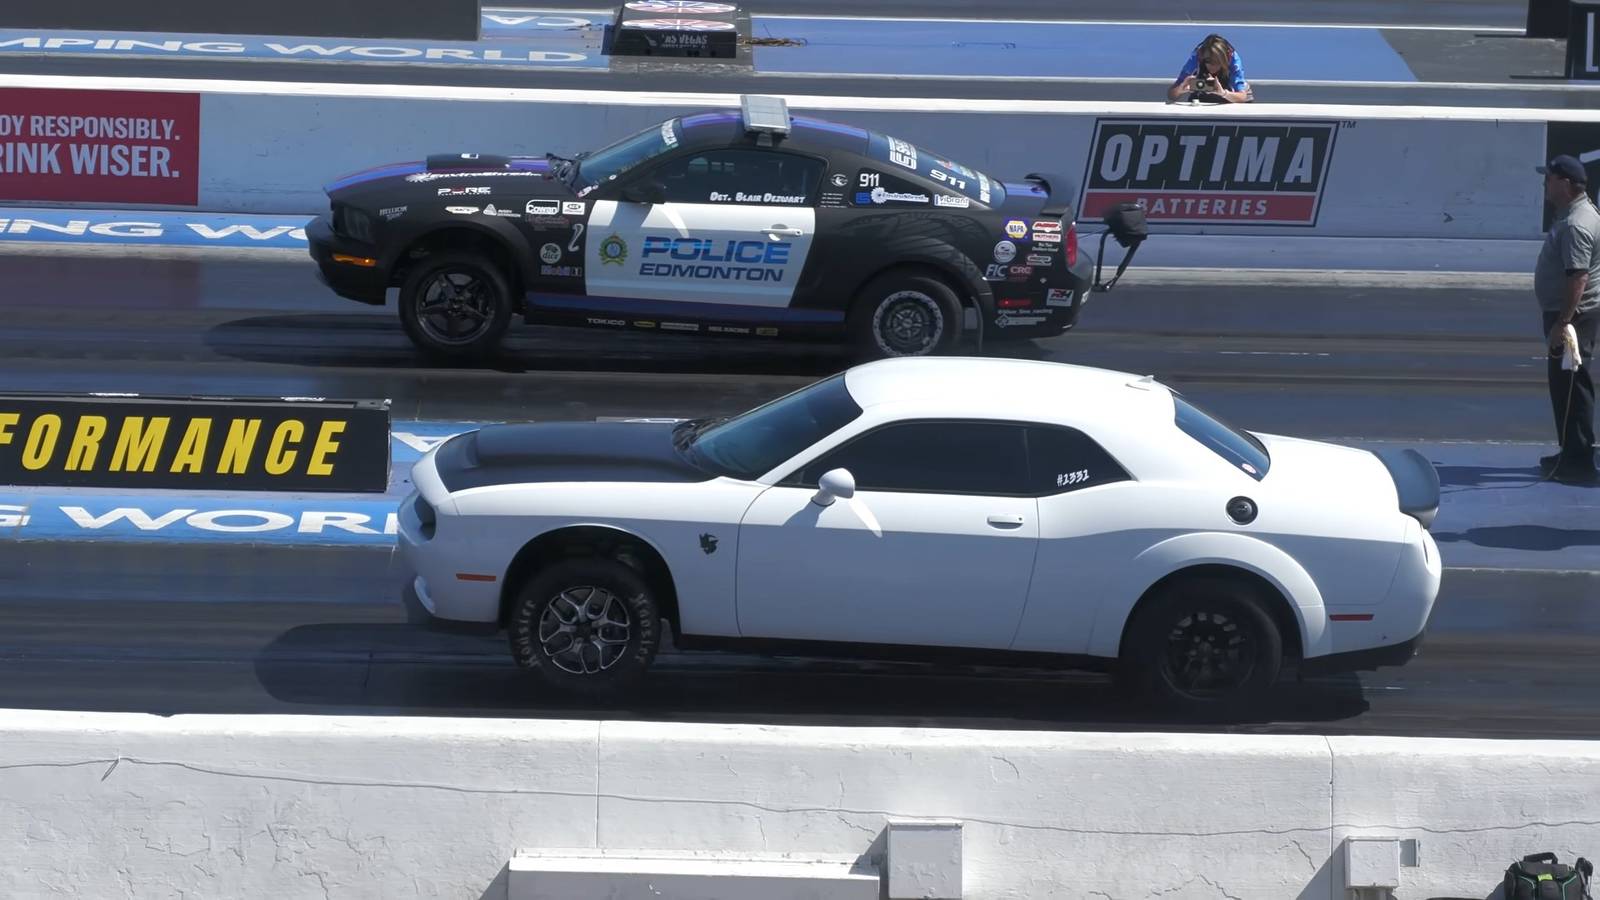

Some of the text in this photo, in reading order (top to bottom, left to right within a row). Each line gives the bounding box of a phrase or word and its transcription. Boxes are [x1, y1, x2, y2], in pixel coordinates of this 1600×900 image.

[662, 34, 708, 45] AS VEGAS
[264, 43, 587, 62] WORLD
[30, 115, 181, 140] RESPONSIBLY.
[69, 145, 181, 178] WISER.
[1100, 133, 1315, 184] OPTIMA
[859, 173, 880, 188] 911
[929, 168, 966, 190] 911
[1136, 198, 1268, 216] BATTERIES
[1008, 224, 1025, 233] NAPA
[641, 236, 792, 264] POLICE
[639, 263, 784, 282] EDMONTON
[0, 413, 347, 476] FORMANCE
